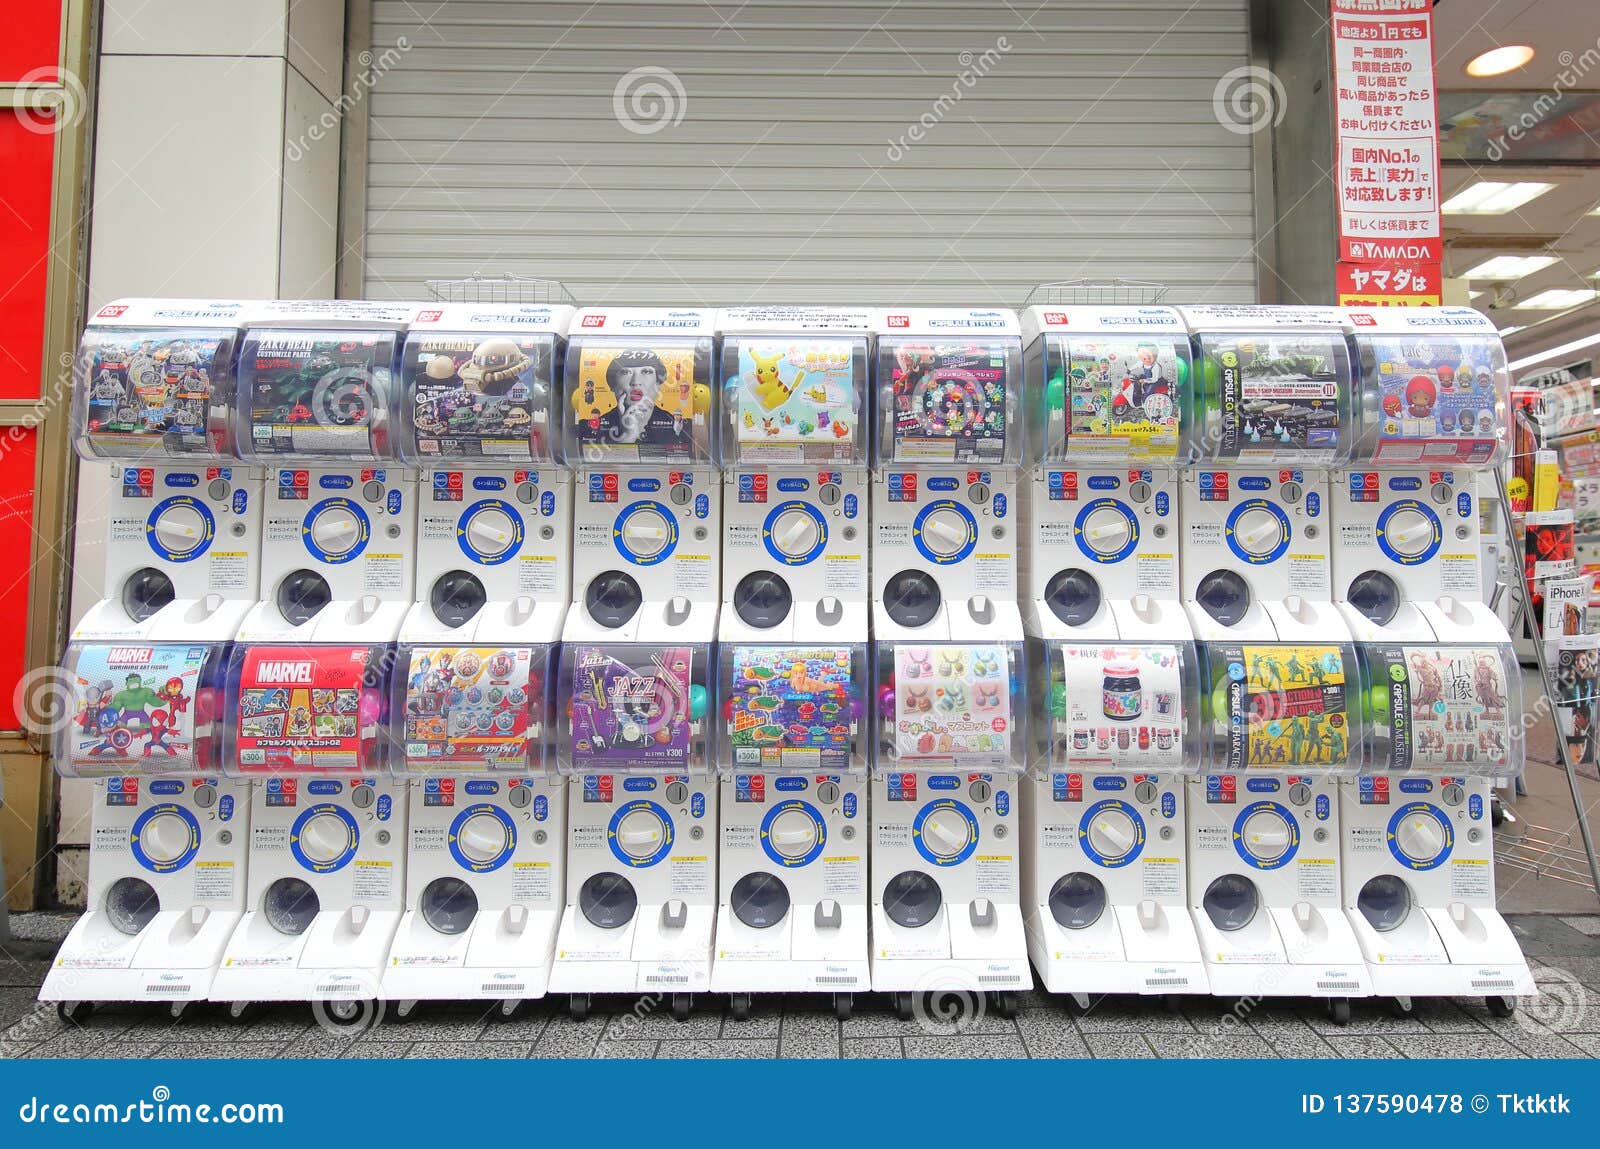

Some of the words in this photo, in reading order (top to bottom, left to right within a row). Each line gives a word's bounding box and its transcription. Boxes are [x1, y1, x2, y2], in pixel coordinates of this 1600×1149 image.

[1341, 22, 1422, 39] 他店より1円でも
[1357, 76, 1407, 87] 同じ商品で
[1339, 89, 1430, 102] 高い商品があったら
[1362, 104, 1403, 116] 係員まで
[1340, 118, 1432, 132] お申し付けください
[1352, 148, 1420, 164] 国内No.1の
[1349, 218, 1429, 231] 詳しくは係員まで
[1363, 242, 1430, 259] YAMADA
[1350, 268, 1427, 291] ヤマダは
[1550, 588, 1581, 599] iPhone
[108, 648, 152, 663] MARVEL
[257, 662, 312, 683] MARVEL
[608, 677, 655, 697] JAZZ
